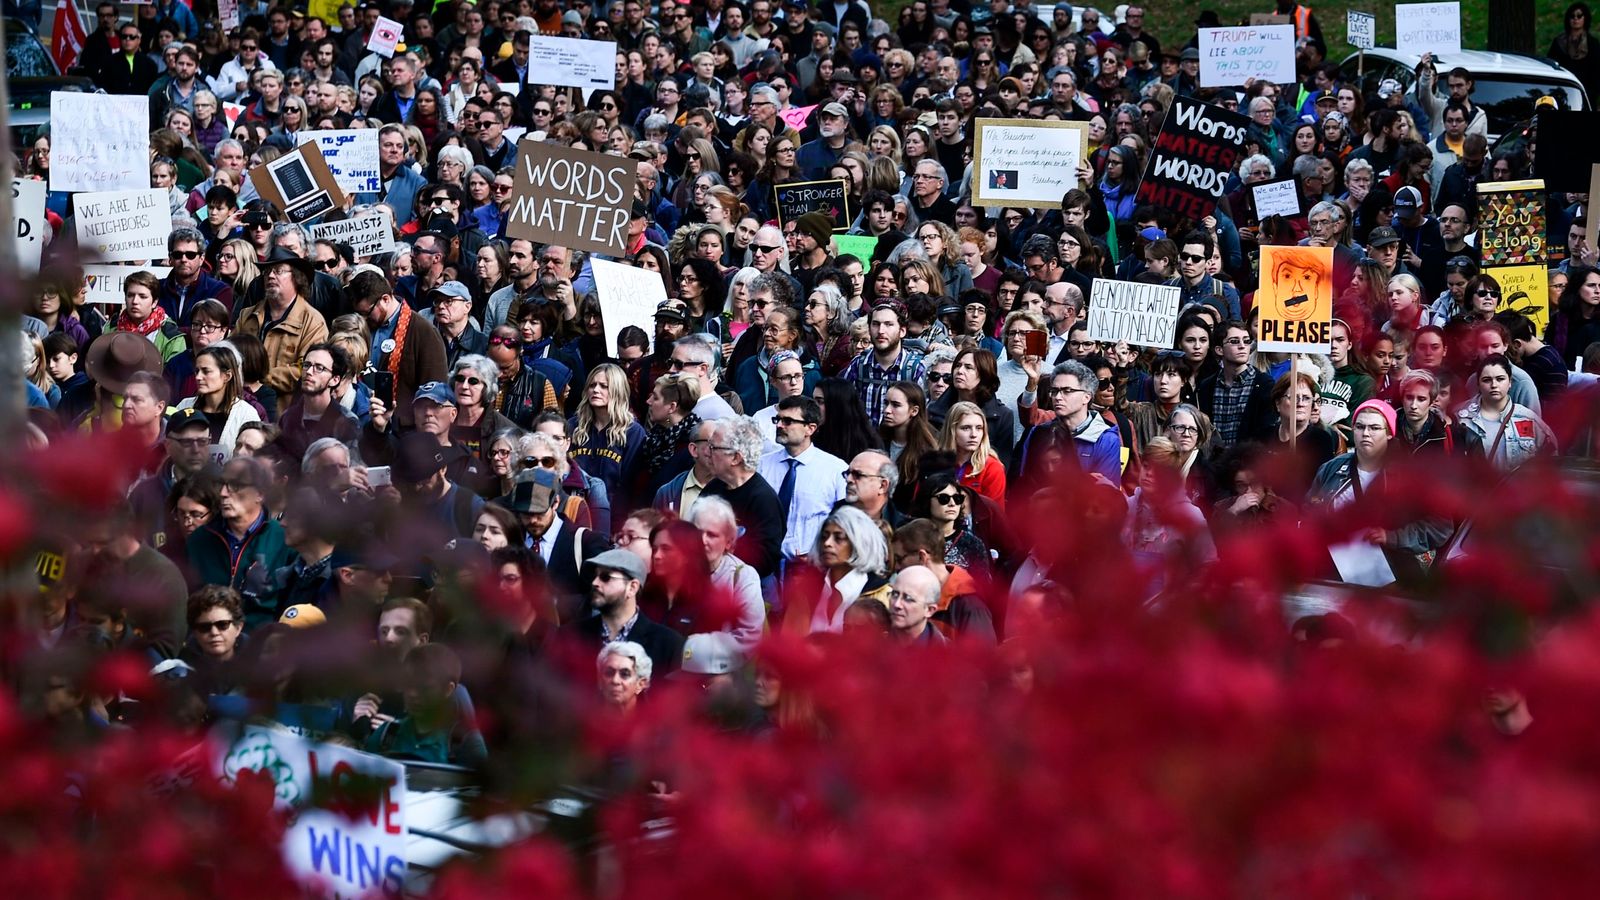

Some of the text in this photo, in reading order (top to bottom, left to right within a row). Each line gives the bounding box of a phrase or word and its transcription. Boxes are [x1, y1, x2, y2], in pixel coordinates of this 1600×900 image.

[1349, 11, 1369, 24] BLACK
[1210, 30, 1282, 43] TRUMP WILL
[1350, 24, 1369, 35] LIVES
[1209, 46, 1265, 57] LIE ABOUT
[1348, 35, 1372, 49] MATTER
[1216, 60, 1240, 71] THIS
[1156, 131, 1237, 170] MATTER
[525, 153, 628, 204] WORDS
[1153, 154, 1230, 197] WORDS
[79, 194, 157, 219] WE ARE ALL
[786, 187, 843, 204] STRONGER
[1137, 180, 1217, 221] MATTER
[782, 203, 808, 216] THAN
[1492, 203, 1532, 227] You
[85, 214, 151, 238] NEIGHBORS
[314, 216, 382, 239] NATIONALISTS
[509, 194, 630, 250] MATTER
[108, 237, 164, 252] SQUIRREL HILL
[358, 242, 383, 255] HERE
[1501, 273, 1536, 284] SAVED A
[1092, 280, 1180, 318] RENOUNCE WHITE
[1089, 309, 1176, 345] NATIONALISM
[1261, 319, 1330, 344] PLEASE
[308, 826, 406, 896] WINS
